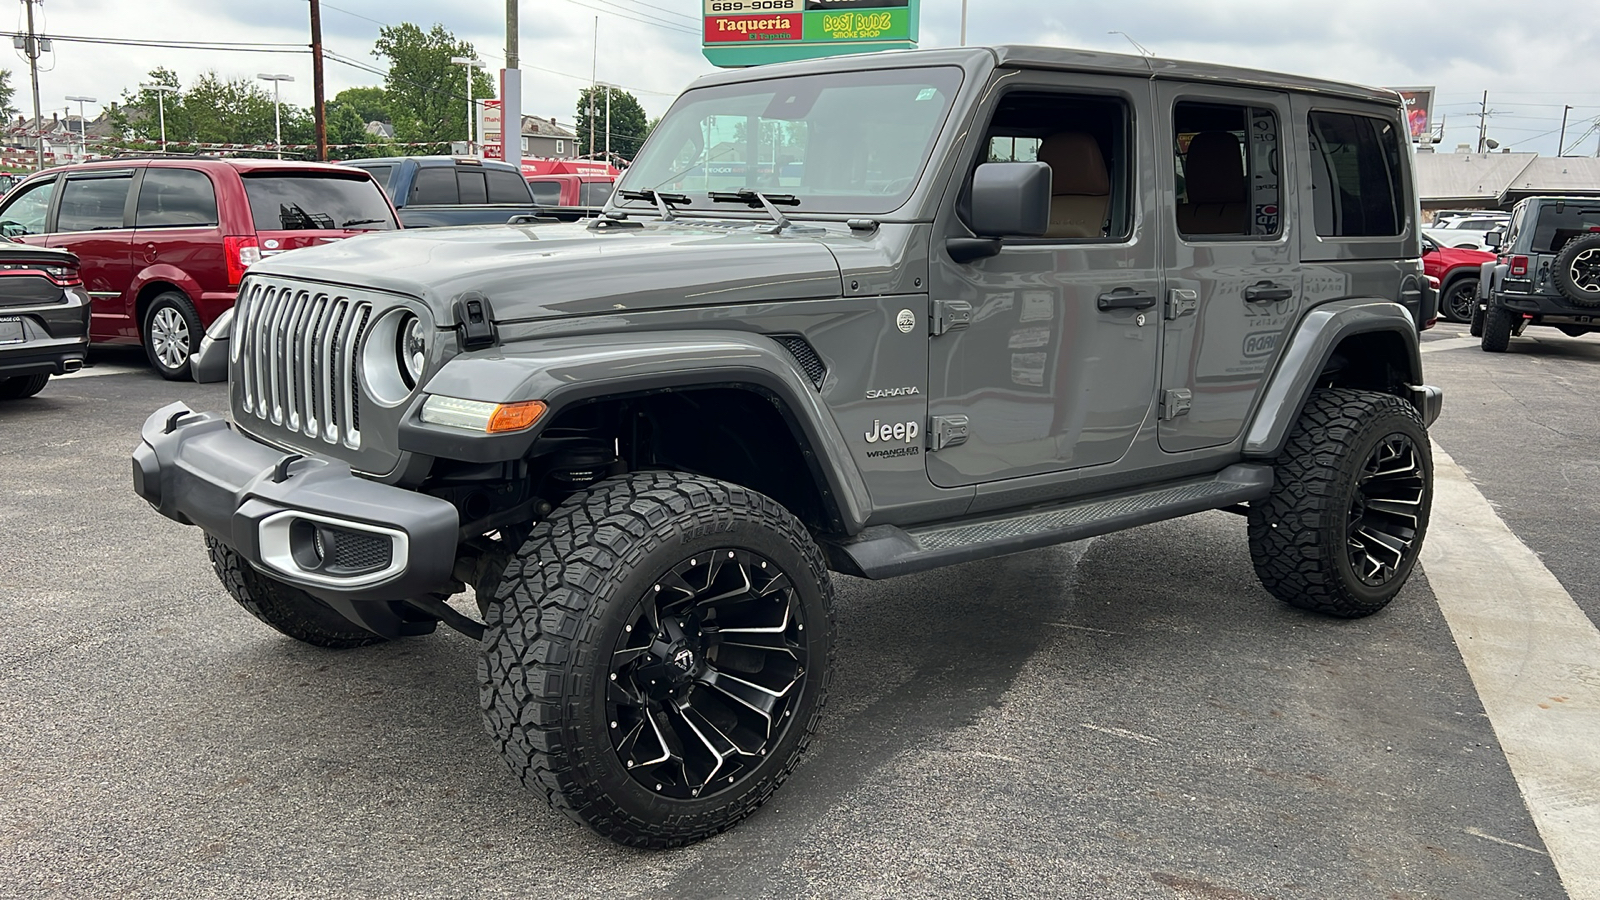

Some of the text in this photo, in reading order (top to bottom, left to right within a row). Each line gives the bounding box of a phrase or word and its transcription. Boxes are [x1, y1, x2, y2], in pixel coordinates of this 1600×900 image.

[712, 0, 794, 11] 689-9088
[833, 30, 881, 39] SMOKE SHOP
[866, 386, 920, 399] SAHARA
[865, 419, 919, 443] Jeep
[866, 446, 919, 458] WRANGLER
